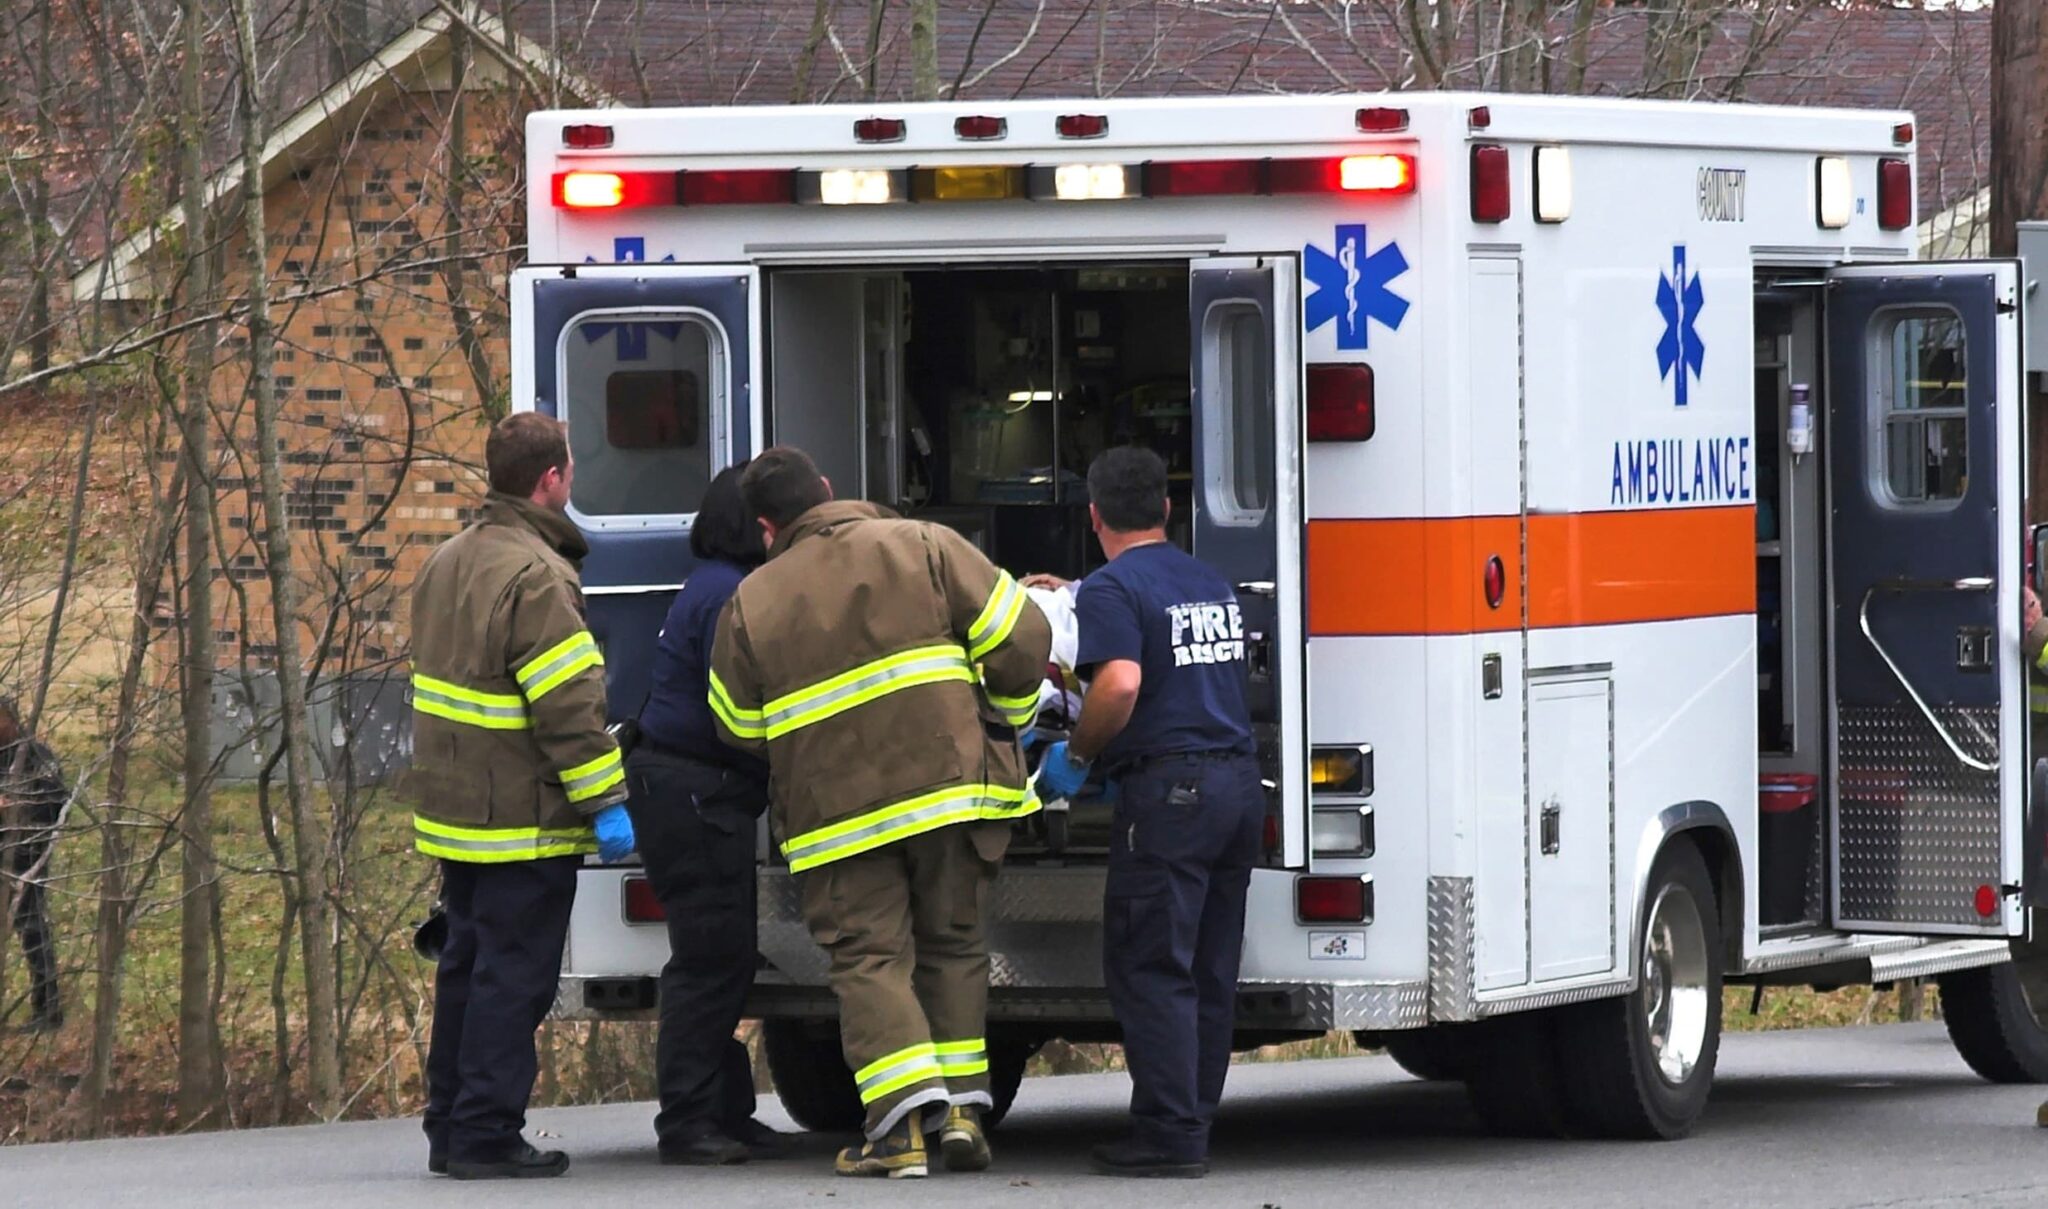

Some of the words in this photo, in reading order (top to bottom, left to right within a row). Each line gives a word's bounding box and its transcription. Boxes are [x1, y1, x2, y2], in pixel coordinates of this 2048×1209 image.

[1697, 166, 1746, 222] COUNTY
[1611, 437, 1750, 504] AMBULANCE
[1171, 604, 1243, 646] FIRE
